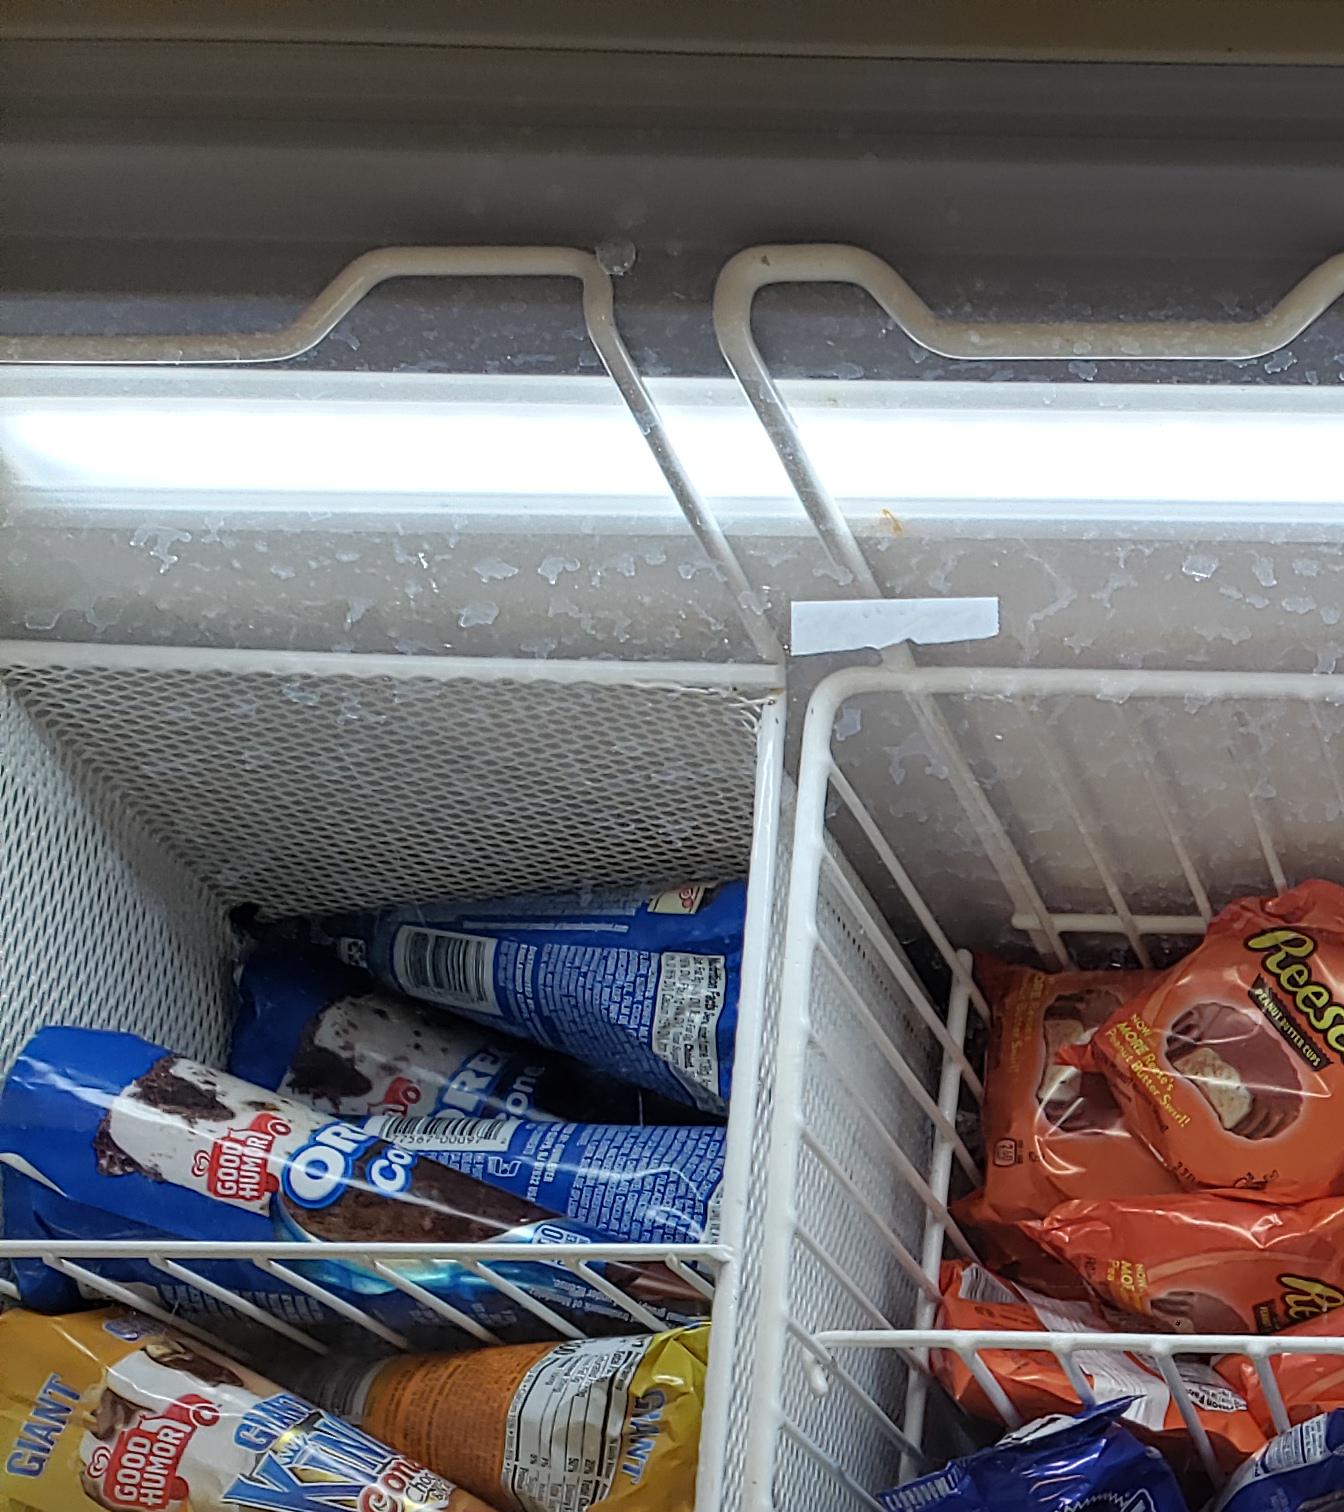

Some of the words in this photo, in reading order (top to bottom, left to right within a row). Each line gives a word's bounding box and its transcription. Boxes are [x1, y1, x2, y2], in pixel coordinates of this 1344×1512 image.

[1301, 1045, 1322, 1068] CUPS
[215, 1141, 242, 1197] GOOD
[5, 1372, 81, 1477] GIANT
[115, 1436, 151, 1501] GOOD
[139, 1420, 191, 1507] HUMOR
